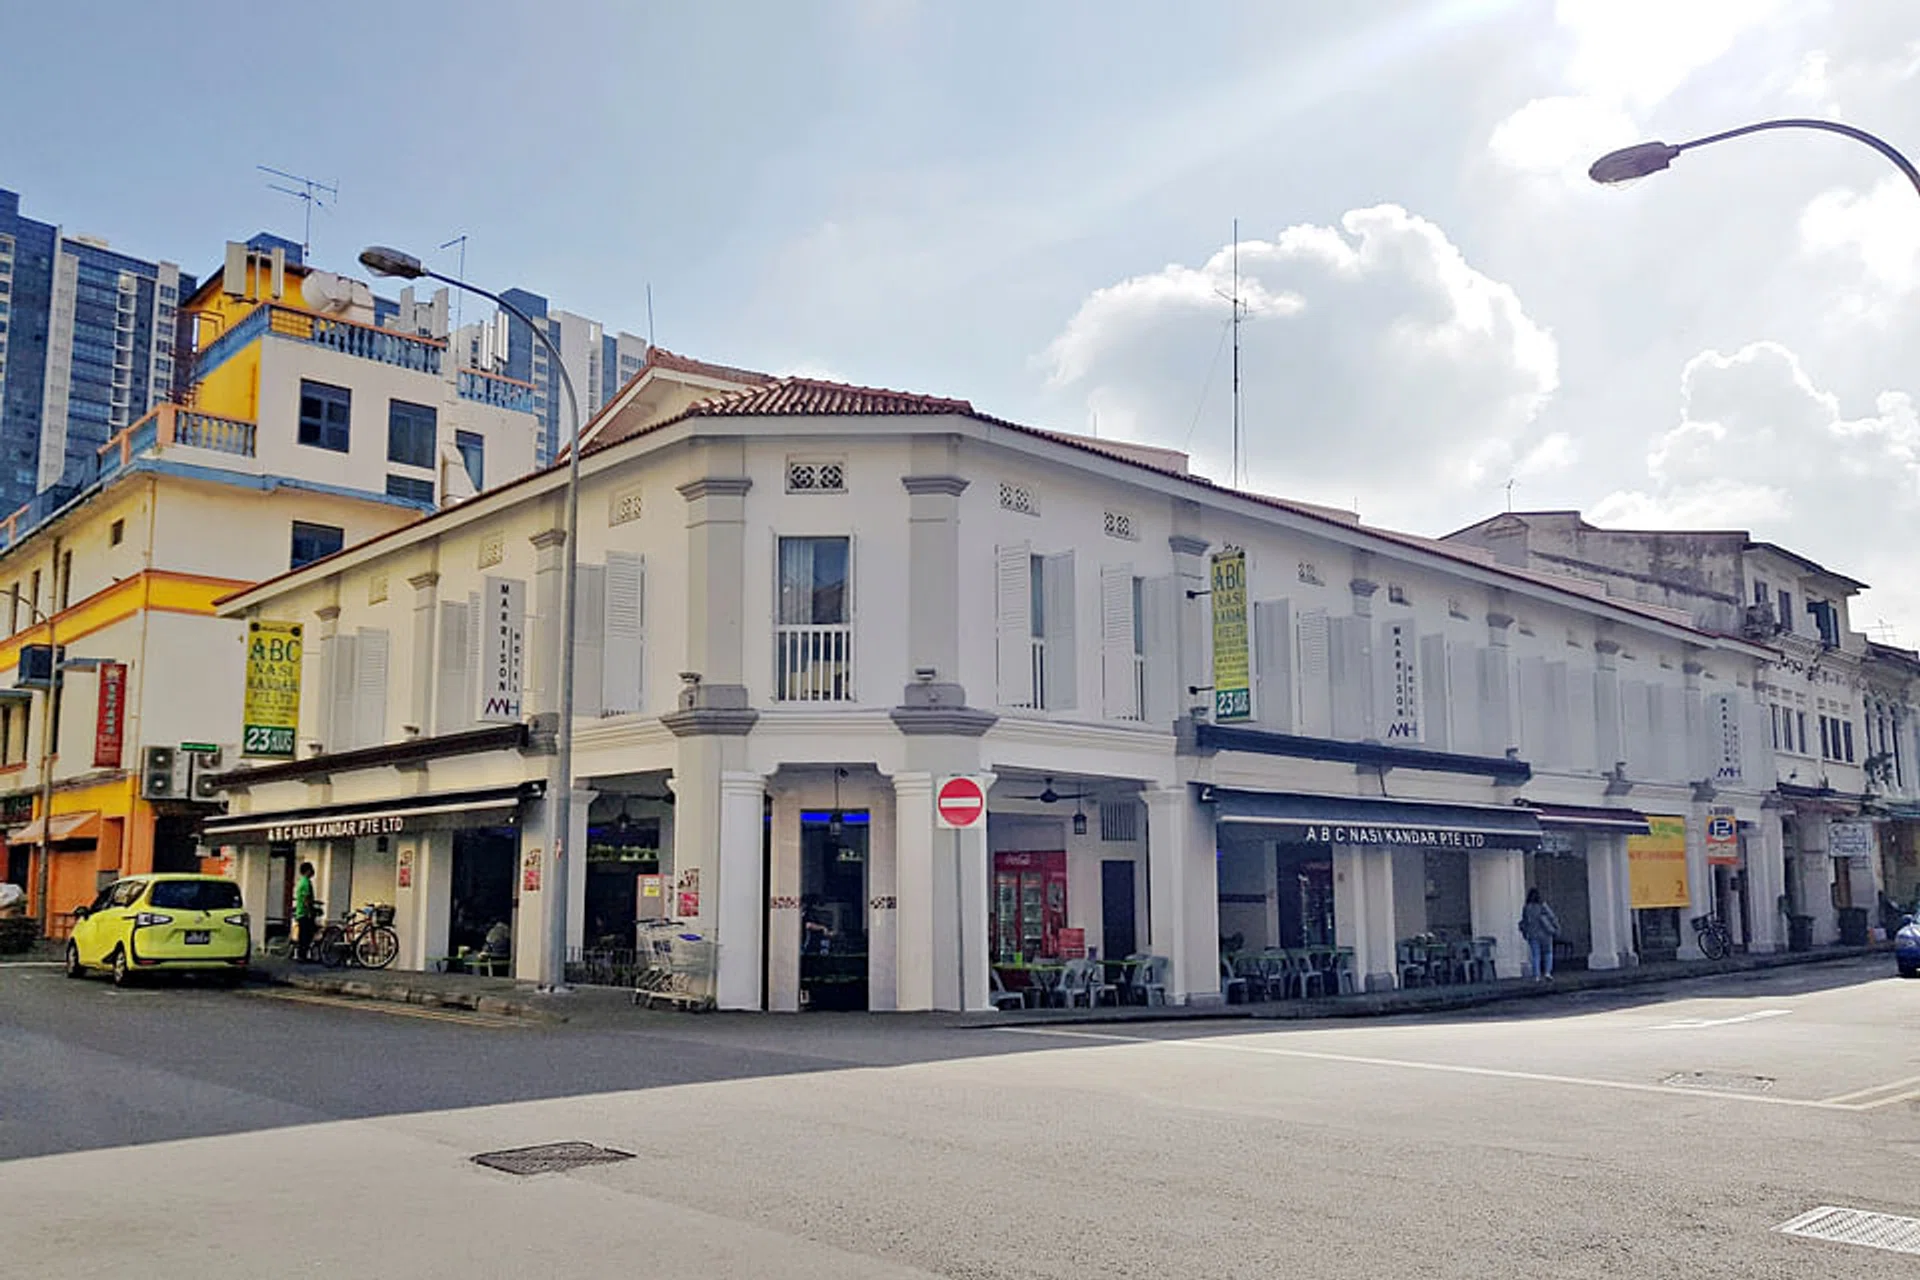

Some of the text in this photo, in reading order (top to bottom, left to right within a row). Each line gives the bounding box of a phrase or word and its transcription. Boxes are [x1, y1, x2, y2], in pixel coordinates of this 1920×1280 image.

[1214, 561, 1245, 591] ABC
[250, 637, 299, 662] ABC
[499, 584, 509, 691] MARRISON
[254, 662, 294, 676] NASI
[1394, 626, 1403, 717] MARRISON
[1218, 691, 1233, 715] 23
[246, 728, 270, 752] 23
[292, 825, 313, 839] NASI
[315, 821, 356, 838] KANDAR
[359, 818, 380, 835] PTE
[382, 817, 403, 833] LTD
[1350, 828, 1383, 842] NASI
[1384, 829, 1437, 845] KANDAR
[1440, 832, 1461, 846] PTE
[1464, 834, 1485, 847] LTD
